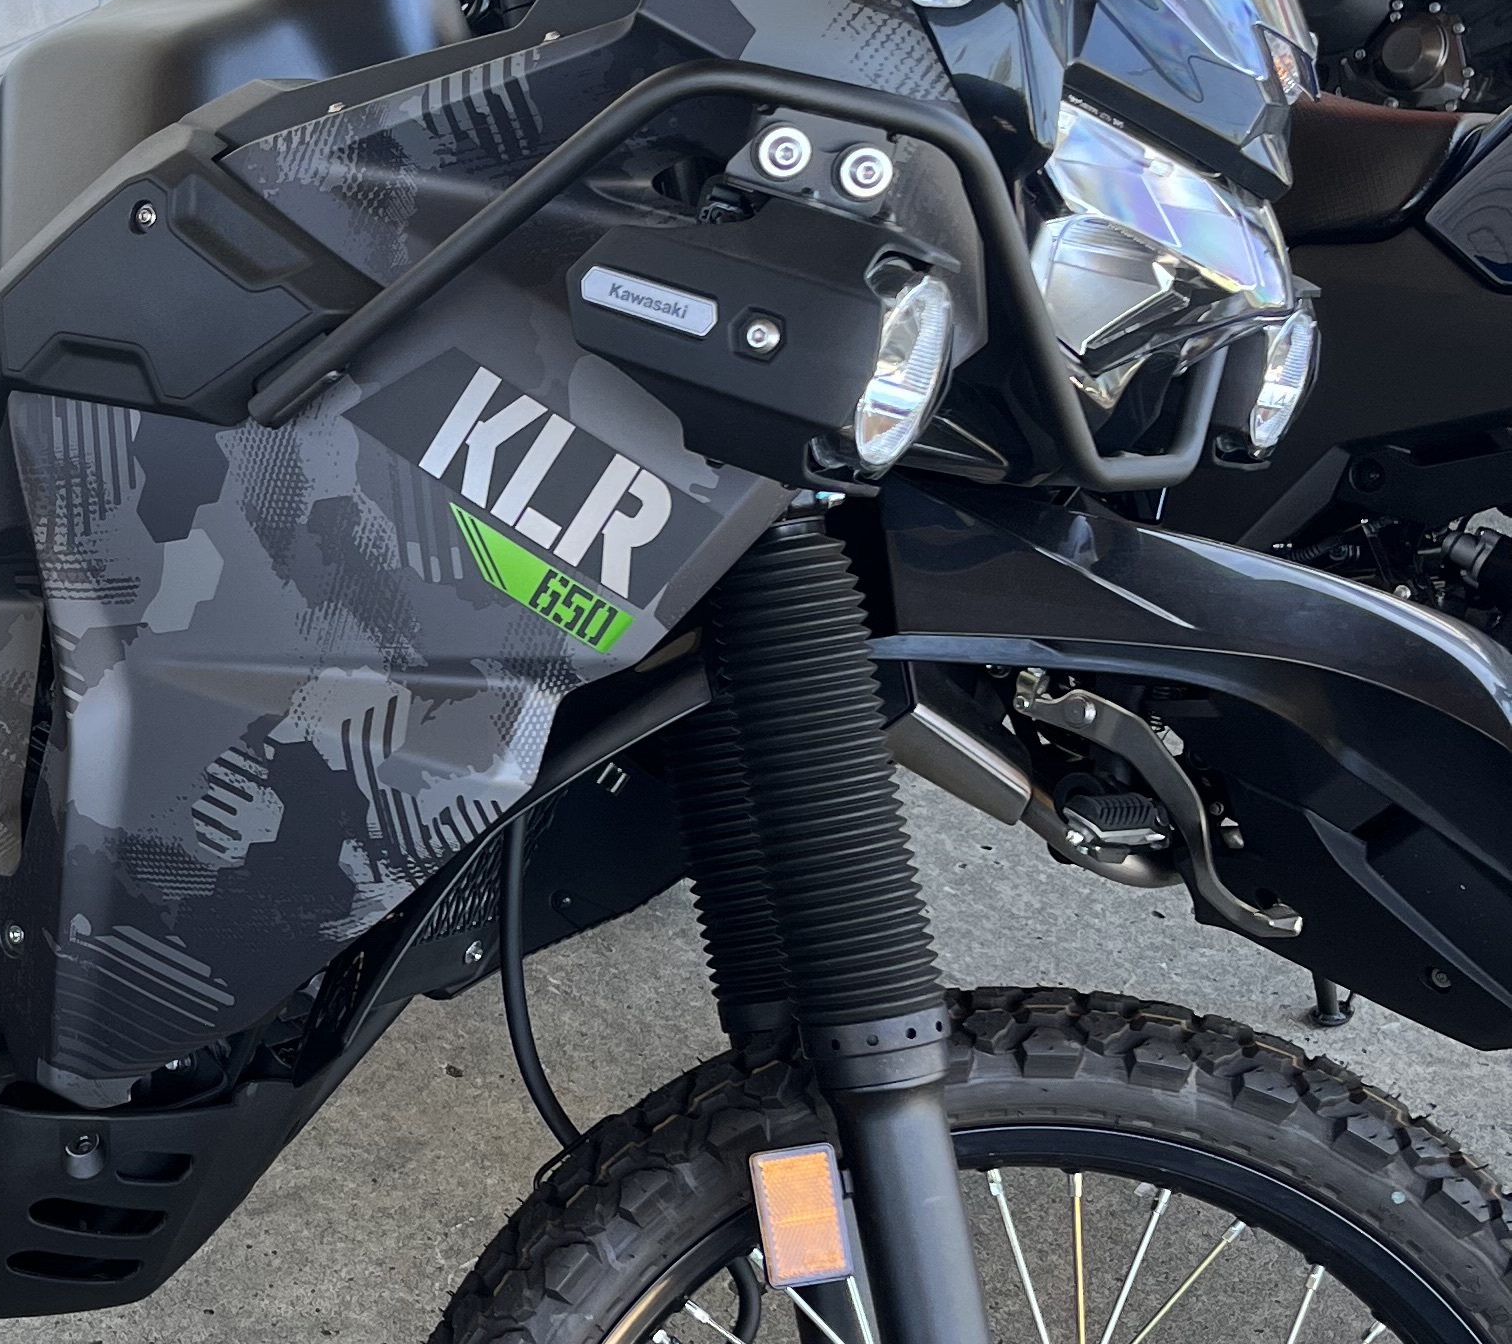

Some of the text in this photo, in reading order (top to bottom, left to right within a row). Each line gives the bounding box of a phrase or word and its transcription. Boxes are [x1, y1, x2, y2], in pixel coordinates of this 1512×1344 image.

[608, 281, 690, 321] Kawasaki
[418, 366, 673, 599] KLR
[528, 567, 618, 646] 650
